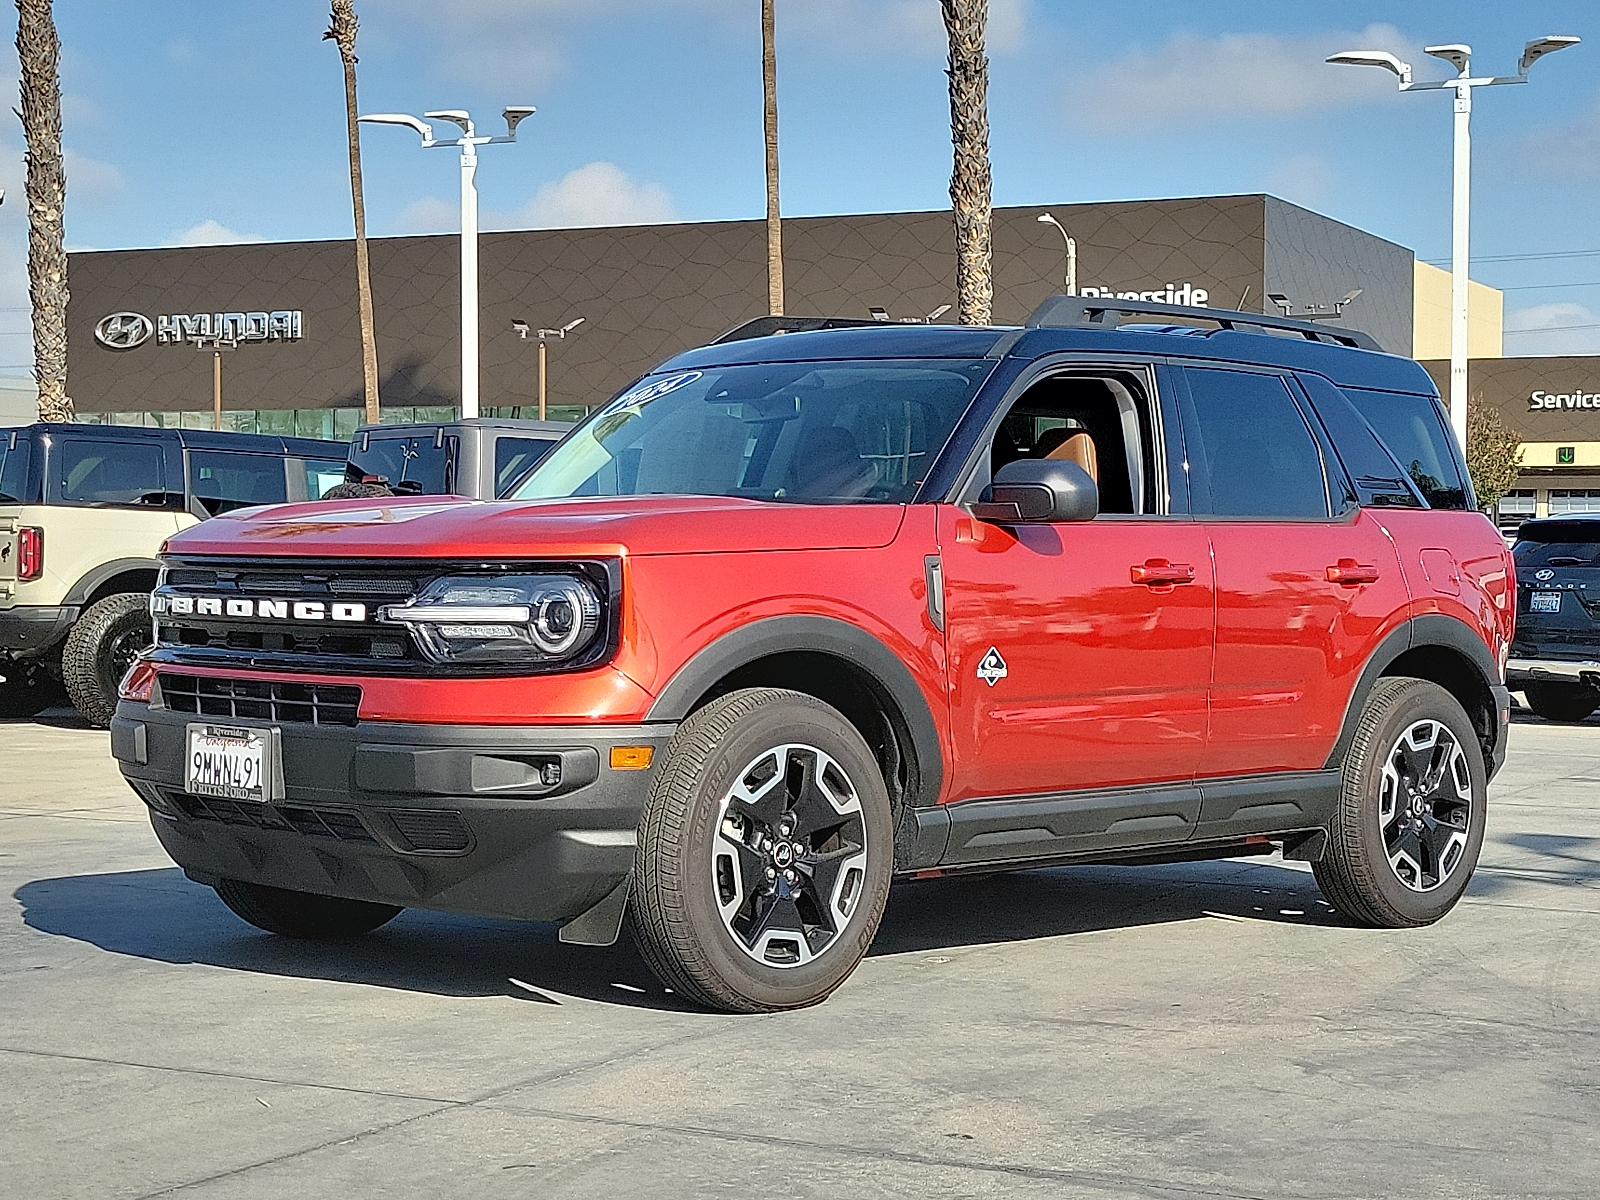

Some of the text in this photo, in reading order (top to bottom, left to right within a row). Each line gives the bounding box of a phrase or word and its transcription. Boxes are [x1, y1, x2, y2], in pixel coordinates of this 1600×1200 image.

[1080, 283, 1208, 309] erside
[157, 310, 303, 342] HYUNDAI
[1530, 389, 1600, 409] Service
[172, 597, 366, 621] BRONCO
[214, 728, 243, 737] Riverside
[193, 751, 262, 788] 9MWN491
[695, 757, 729, 844] MICHELIN
